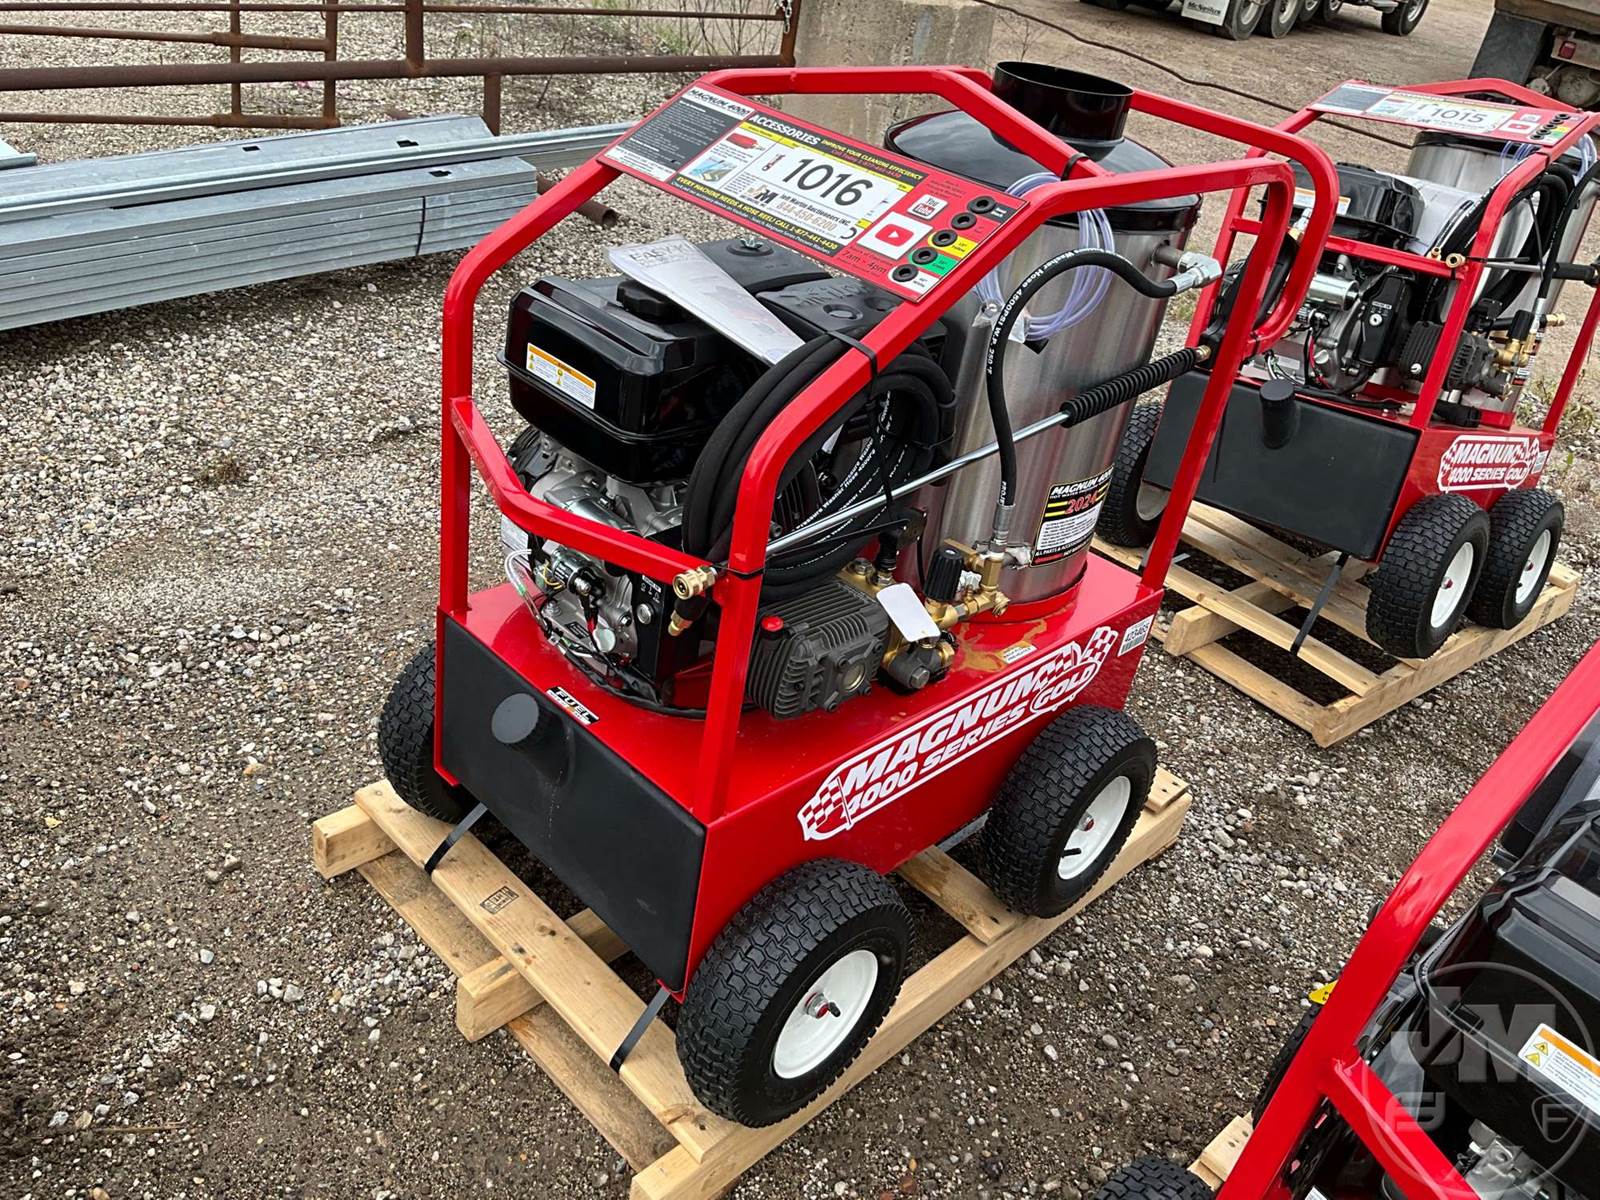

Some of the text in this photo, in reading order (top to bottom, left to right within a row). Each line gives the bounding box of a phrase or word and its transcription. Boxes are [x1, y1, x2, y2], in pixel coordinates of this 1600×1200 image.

[1431, 108, 1488, 123] 1015
[748, 113, 822, 145] ACCESSORIES
[844, 148, 863, 157] YOUR
[860, 154, 890, 168] CLEANING
[887, 164, 923, 180] EFFICIENCY
[782, 157, 874, 206] 1016
[675, 176, 695, 187] EVERY
[691, 183, 721, 198] MACHINE
[717, 195, 739, 206] NEEDS
[740, 205, 760, 215] HOSE
[773, 219, 791, 229] CALL
[1043, 251, 1075, 270] Washer
[1022, 268, 1045, 288] Hose
[998, 288, 1023, 326] 4500PSI
[1451, 443, 1519, 464] MAGNUM
[1051, 477, 1099, 496] MAGNUM
[1471, 467, 1508, 481] SERIES
[1505, 466, 1528, 480] GOLD
[1064, 490, 1098, 514] 2024
[555, 690, 591, 721] FUEL
[919, 700, 1030, 774] SERIES
[1033, 663, 1096, 710] GOLD
[843, 663, 1054, 796] MAGNUM
